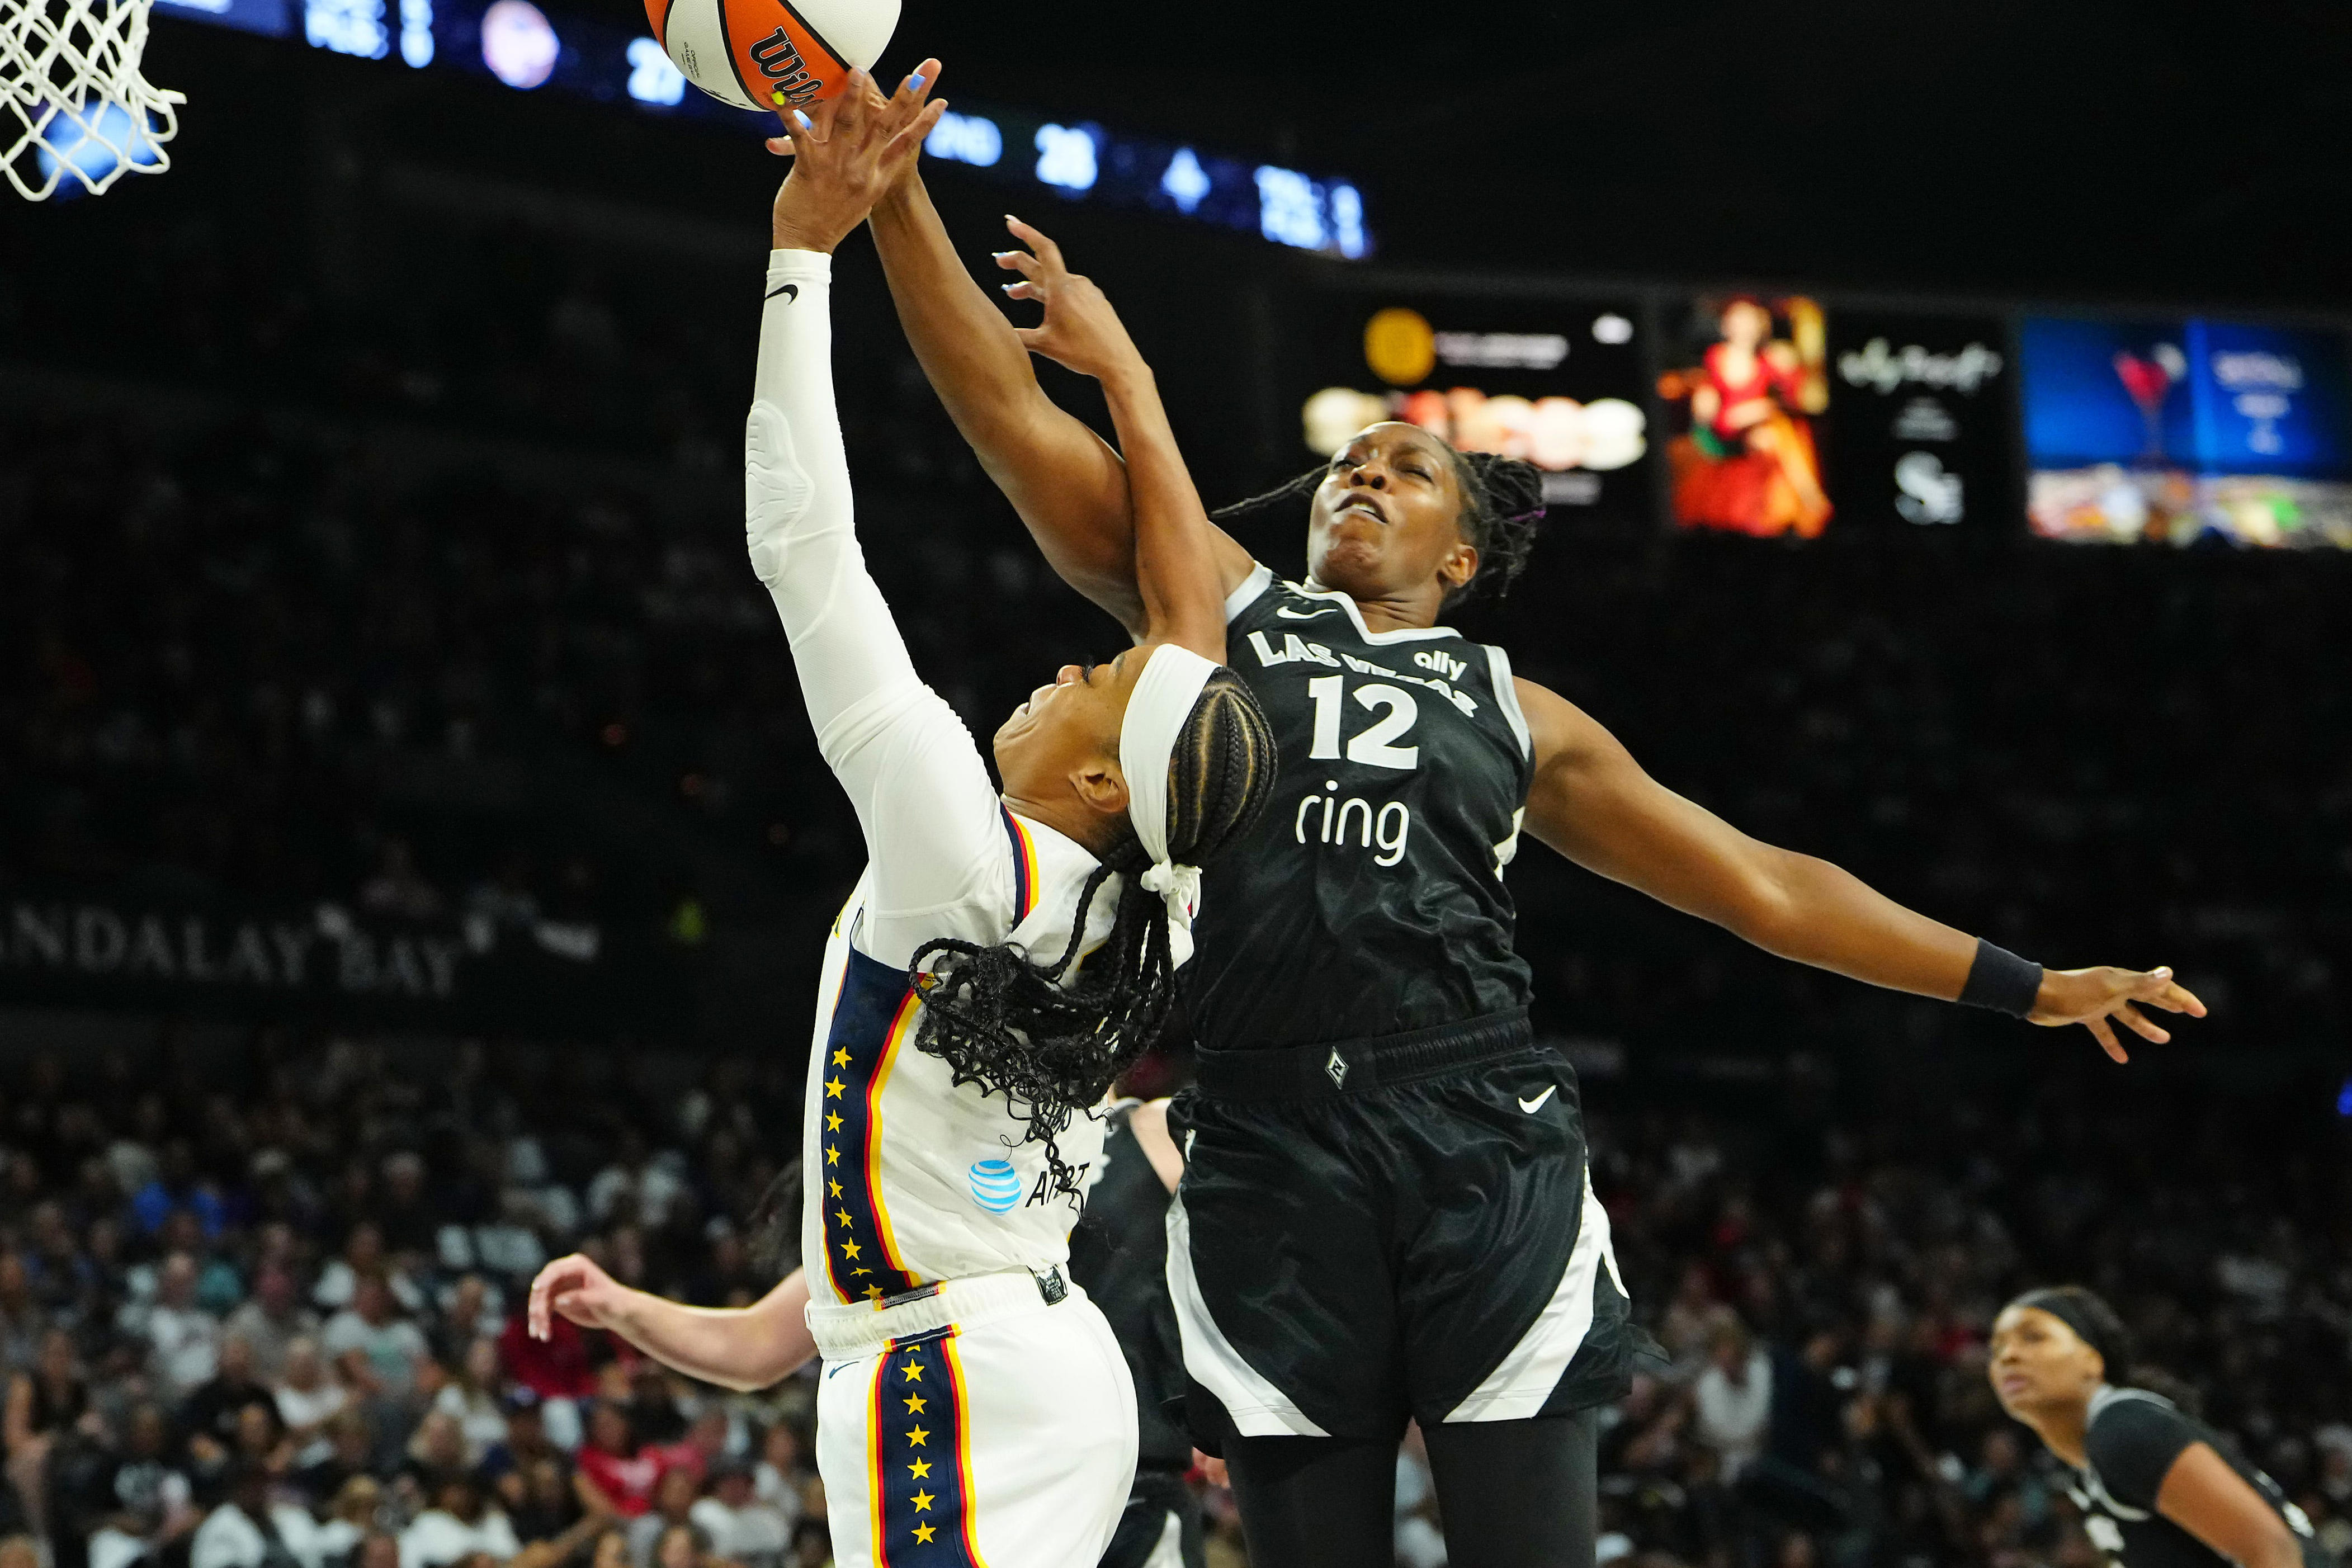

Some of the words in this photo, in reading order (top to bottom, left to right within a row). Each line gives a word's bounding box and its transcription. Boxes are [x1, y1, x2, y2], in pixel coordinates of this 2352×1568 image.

[1246, 630, 1342, 668] LAS
[1340, 653, 1478, 718] VAS
[1413, 650, 1467, 682] ally
[1308, 674, 1419, 770] 12
[1295, 780, 1410, 867] ring
[0, 901, 320, 986] NDALAY
